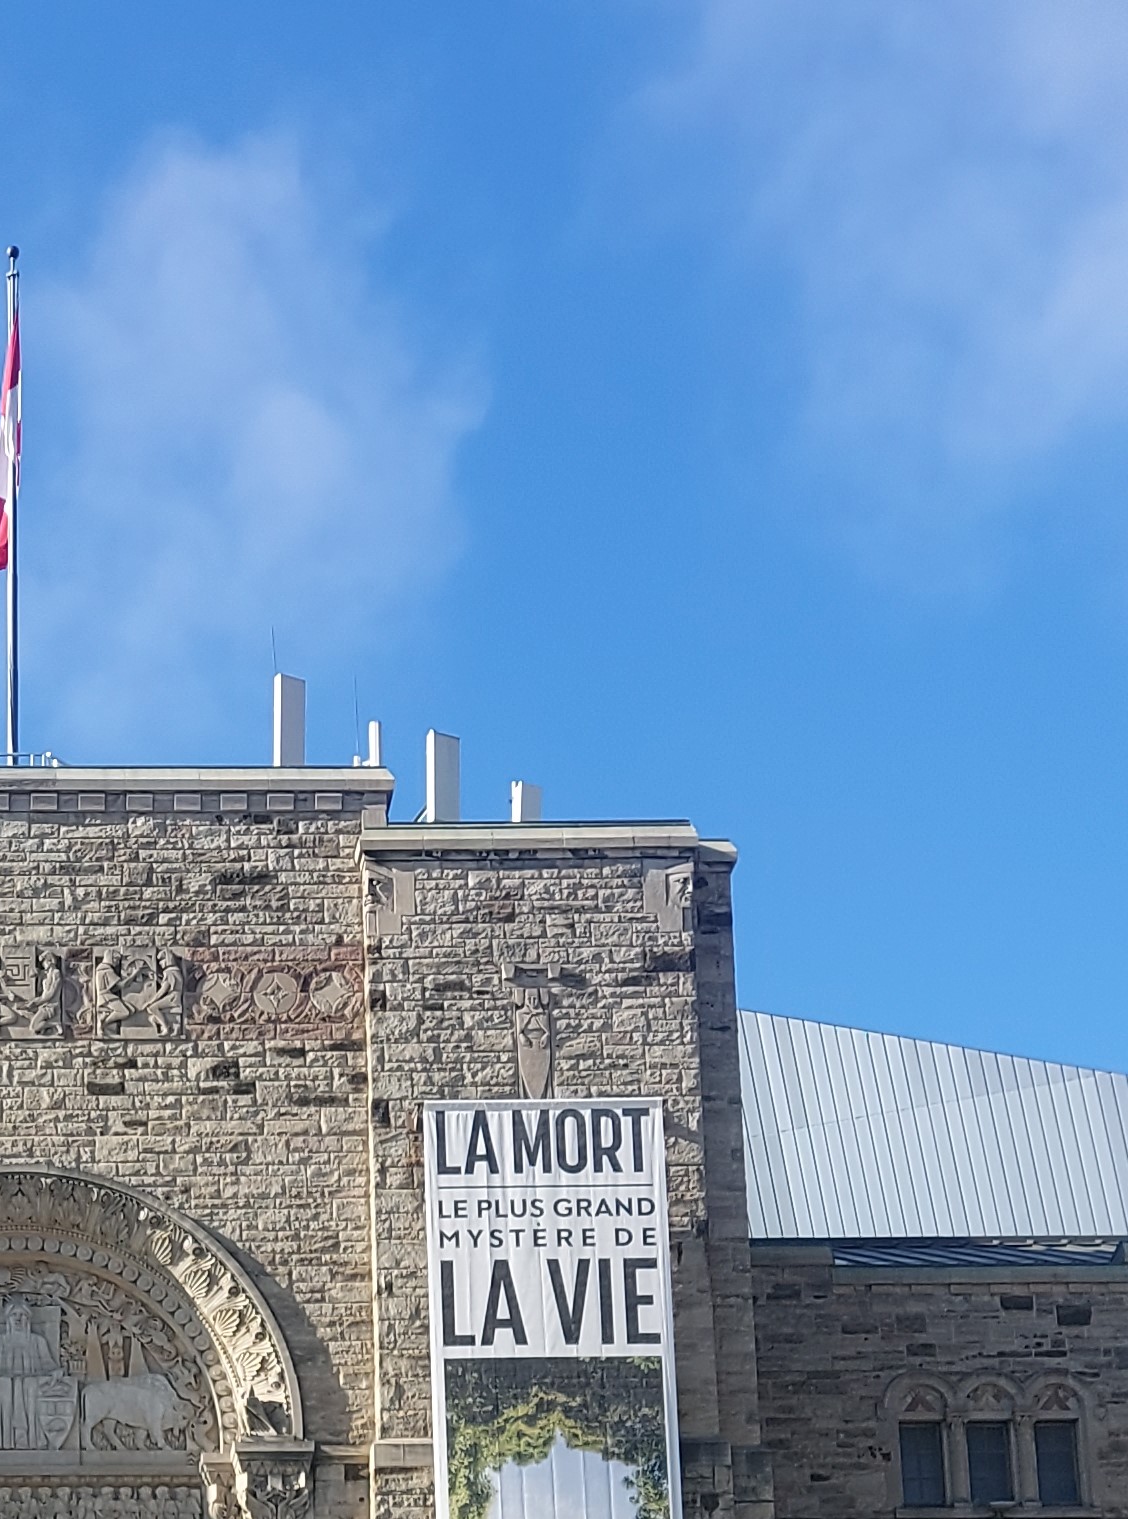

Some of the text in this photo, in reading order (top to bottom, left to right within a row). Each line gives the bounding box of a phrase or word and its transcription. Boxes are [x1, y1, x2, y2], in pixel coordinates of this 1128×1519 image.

[435, 1107, 650, 1175] LA MORT
[438, 1197, 656, 1218] LE PLUS GRAND
[439, 1222, 657, 1249] MYSTÈRE DE
[440, 1257, 662, 1346] LA VIE
